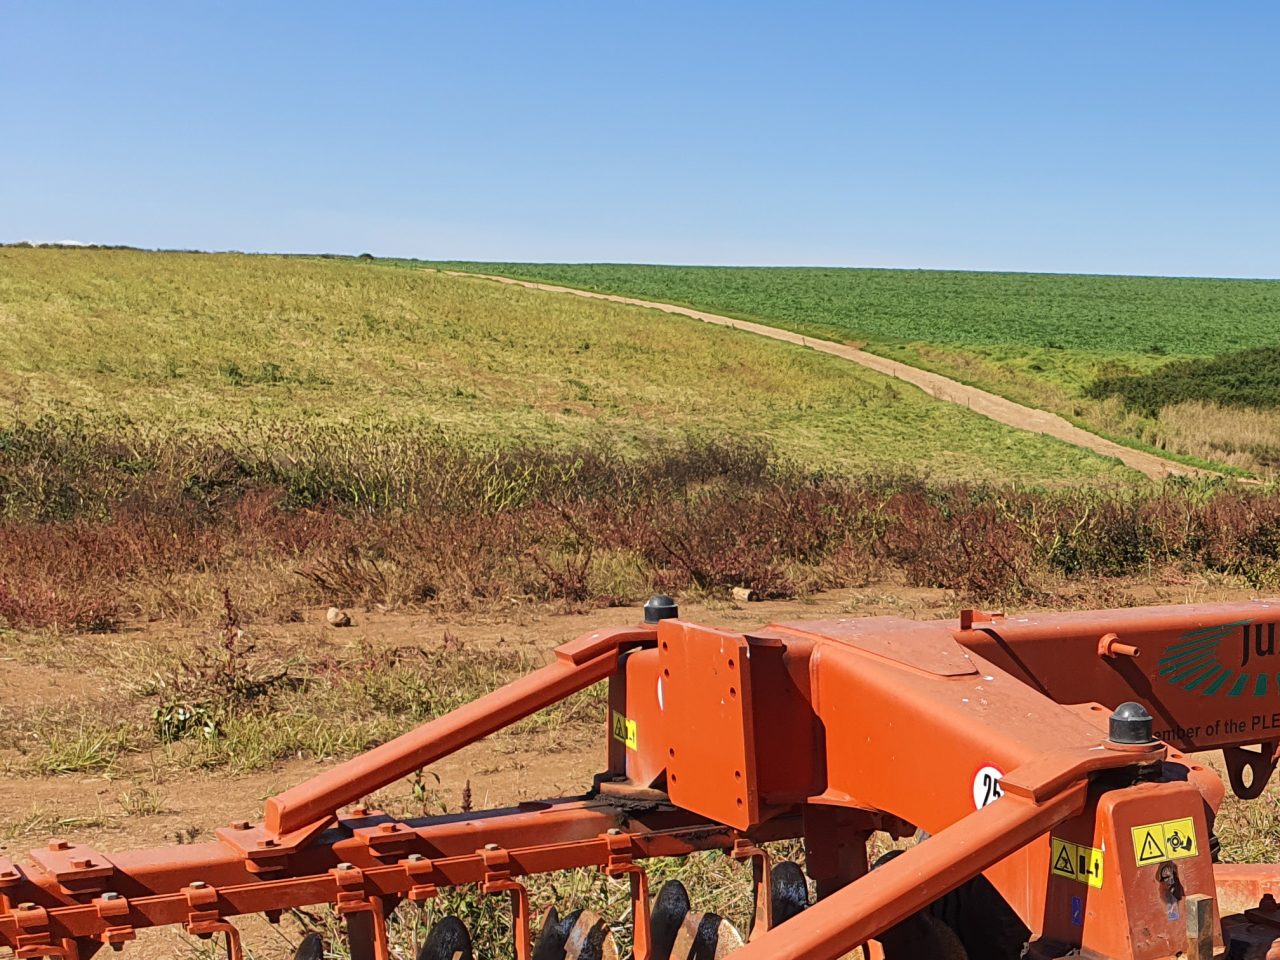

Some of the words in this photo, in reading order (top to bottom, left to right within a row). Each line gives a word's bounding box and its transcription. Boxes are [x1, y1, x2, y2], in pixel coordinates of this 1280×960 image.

[1153, 724, 1201, 742] ember
[1205, 719, 1222, 736] of
[1224, 718, 1247, 734] the
